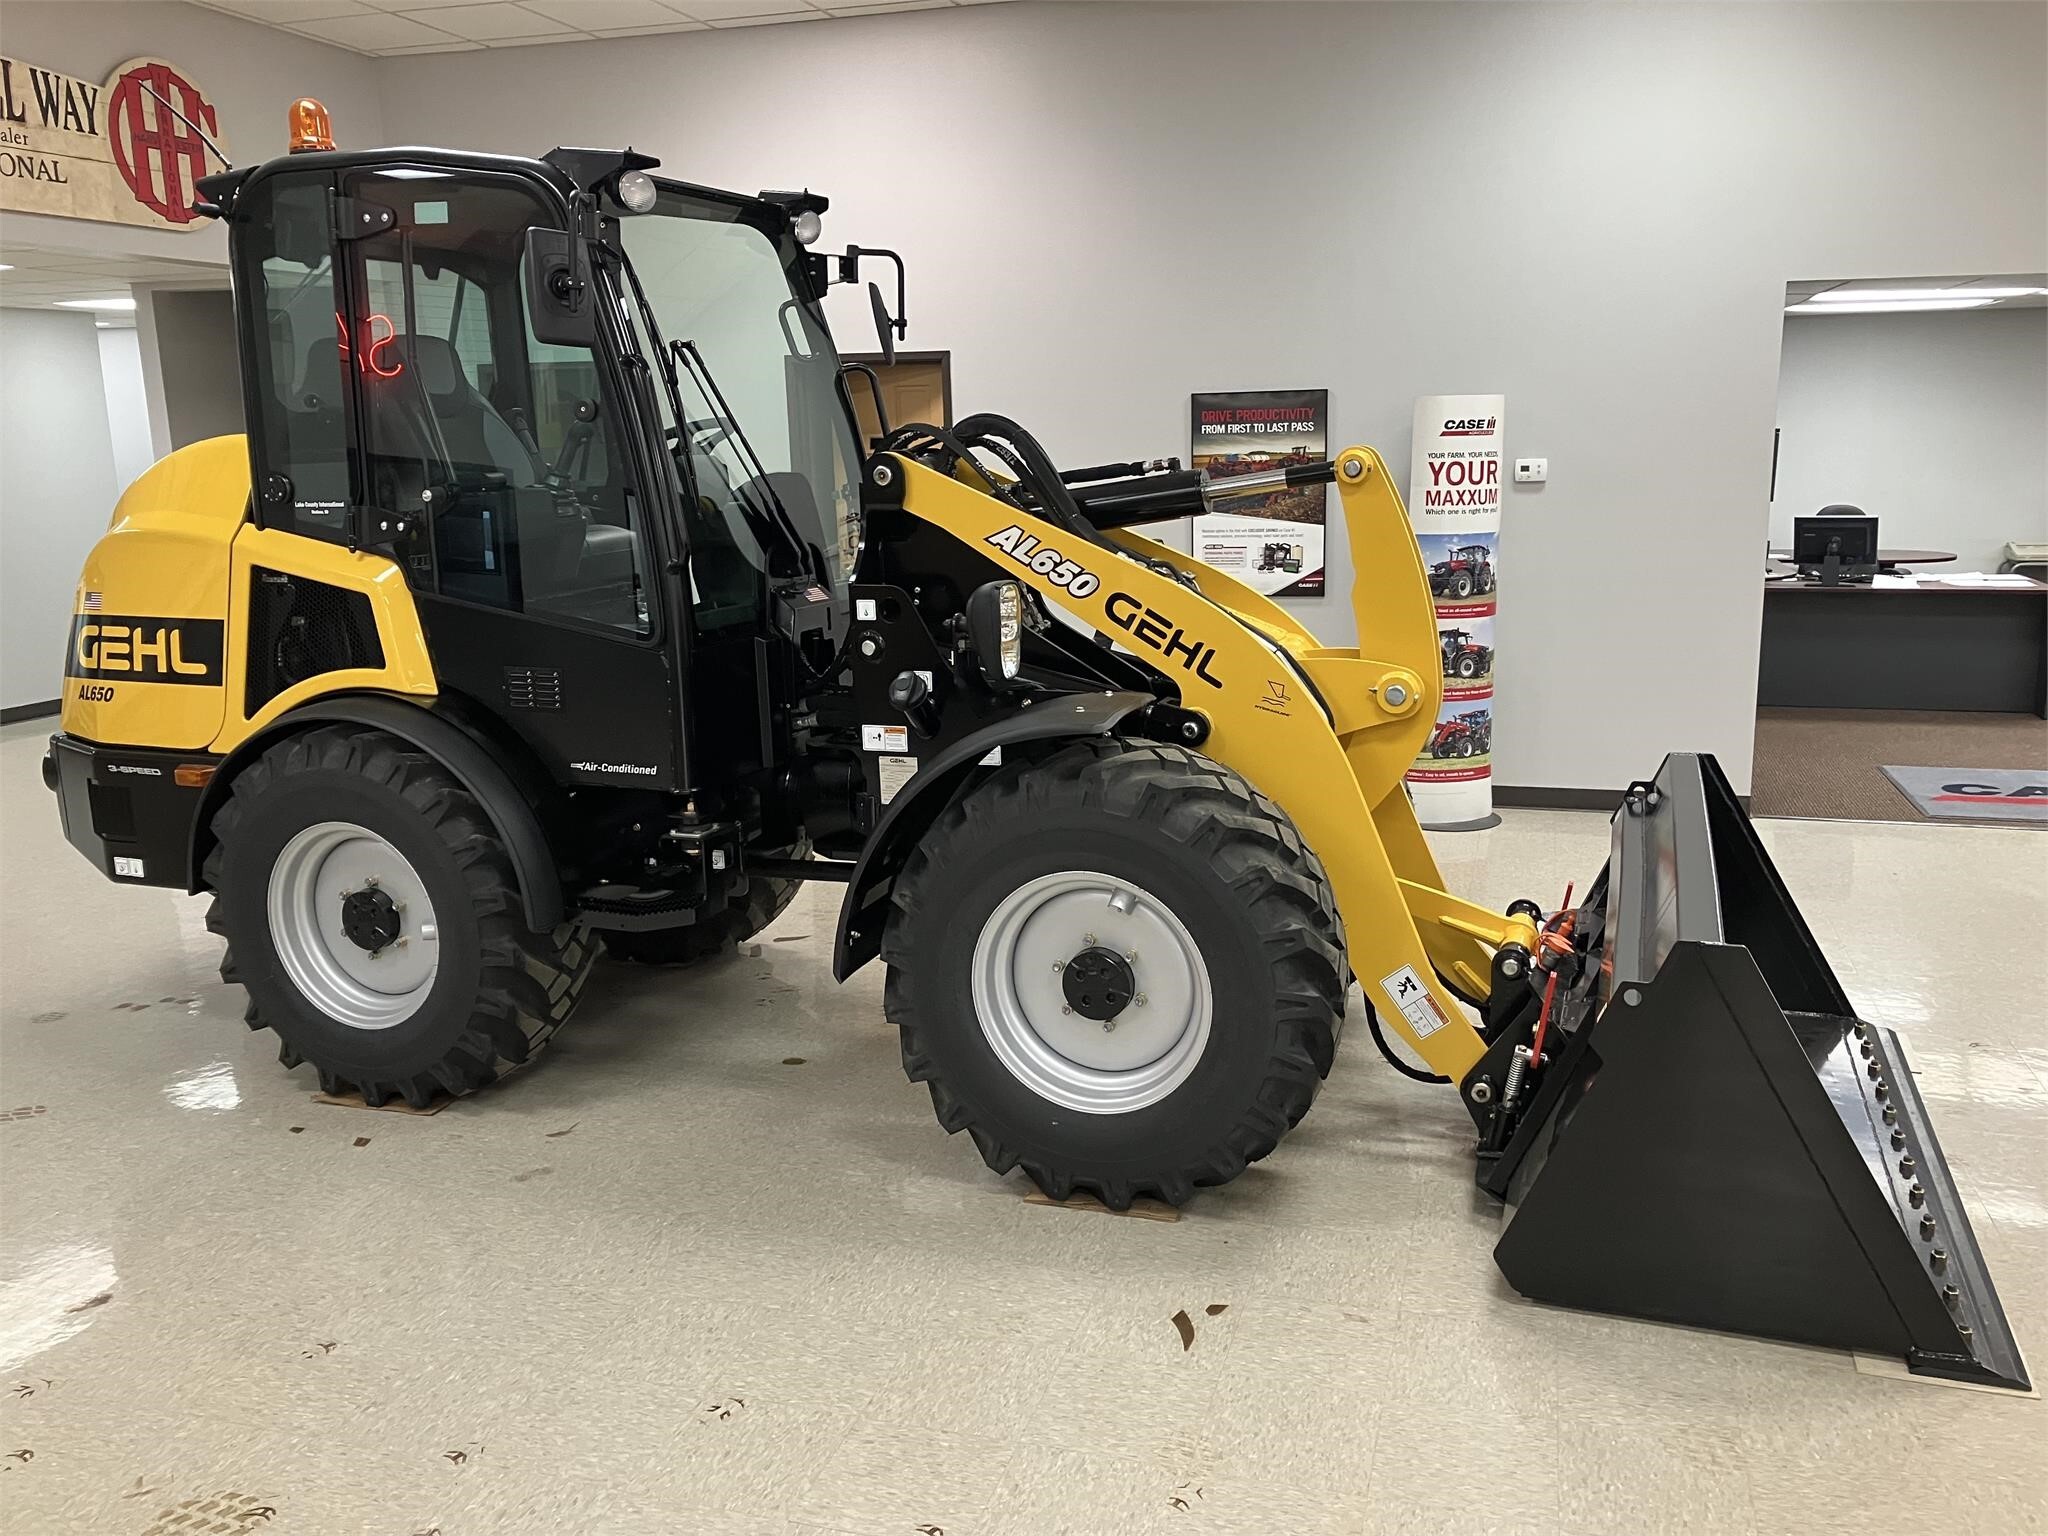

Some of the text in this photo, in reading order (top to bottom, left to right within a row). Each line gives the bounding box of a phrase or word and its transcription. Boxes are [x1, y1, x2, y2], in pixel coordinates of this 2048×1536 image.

[29, 67, 98, 136] WAY
[1201, 407, 1314, 422] DRIVE PRODUCTIVITY
[1201, 421, 1315, 435] FROM FIRST TO LAST PASS
[1444, 419, 1486, 430] CASE
[1428, 460, 1498, 486] YOUR
[1425, 488, 1498, 506] MAXXUM
[983, 525, 1101, 598] AL650
[1104, 592, 1223, 689] GEHL
[77, 624, 208, 676] GEHL
[78, 684, 115, 703] AL650
[107, 764, 162, 776] 3-SPEED
[583, 762, 658, 776] Air-Conditioned
